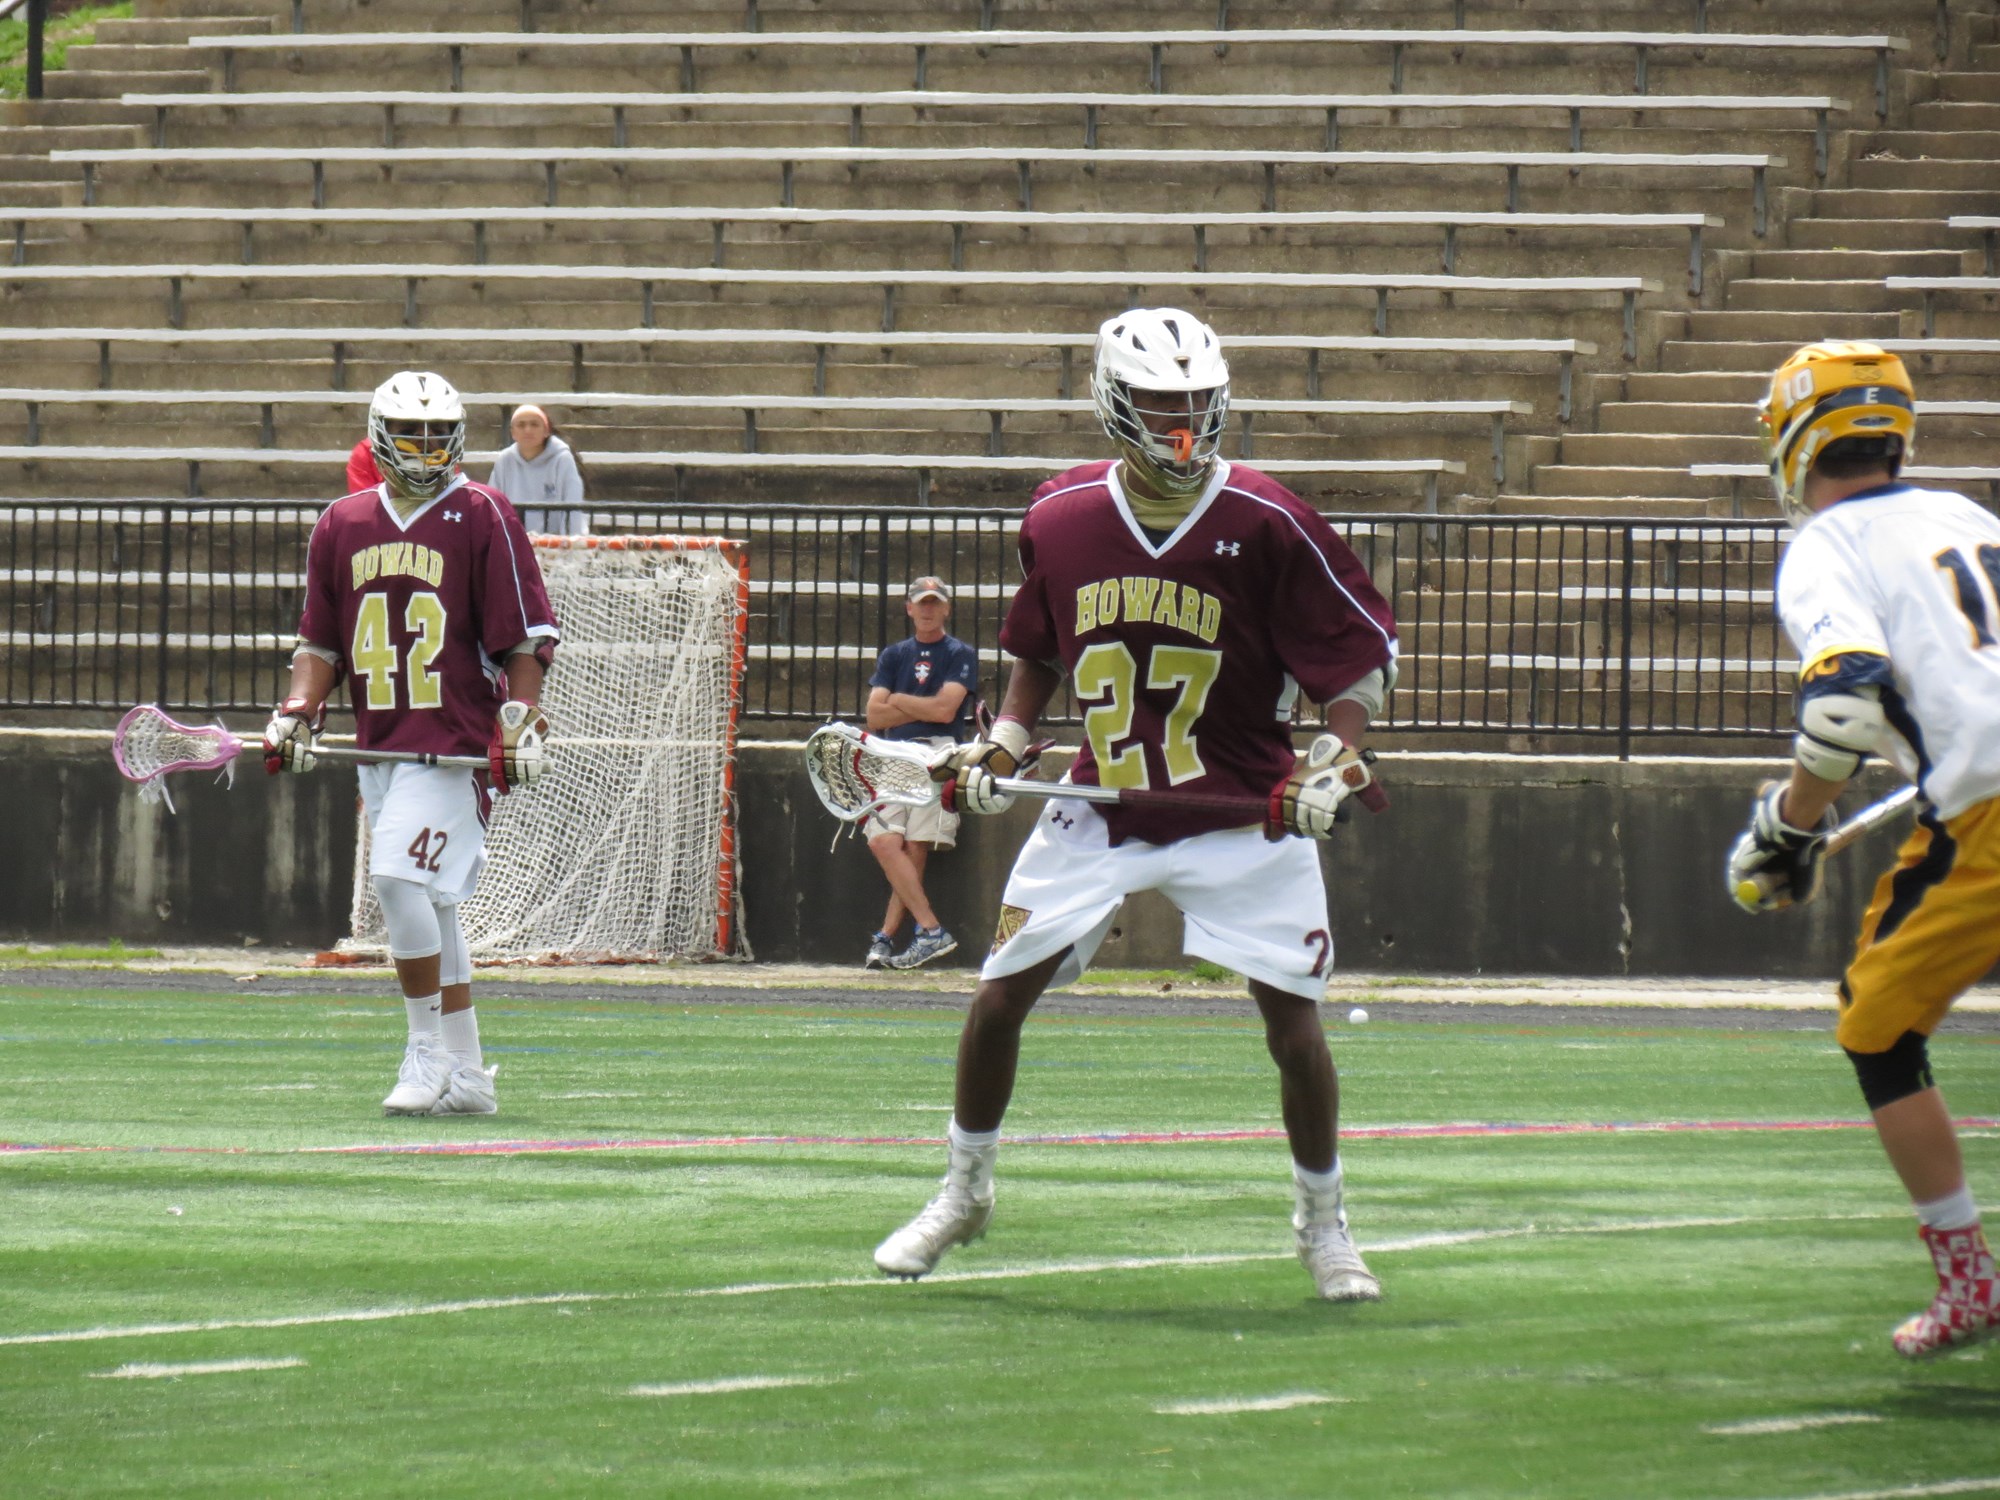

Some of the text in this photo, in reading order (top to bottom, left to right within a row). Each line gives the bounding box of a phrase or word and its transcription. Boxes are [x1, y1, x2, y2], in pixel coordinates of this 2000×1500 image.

[1783, 368, 1814, 411] 10
[1865, 387, 1880, 404] E
[352, 542, 444, 591] HOWARD
[1075, 577, 1221, 643] HOWARD
[352, 592, 447, 710] 42
[1074, 641, 1222, 790] 27
[407, 826, 448, 874] 42
